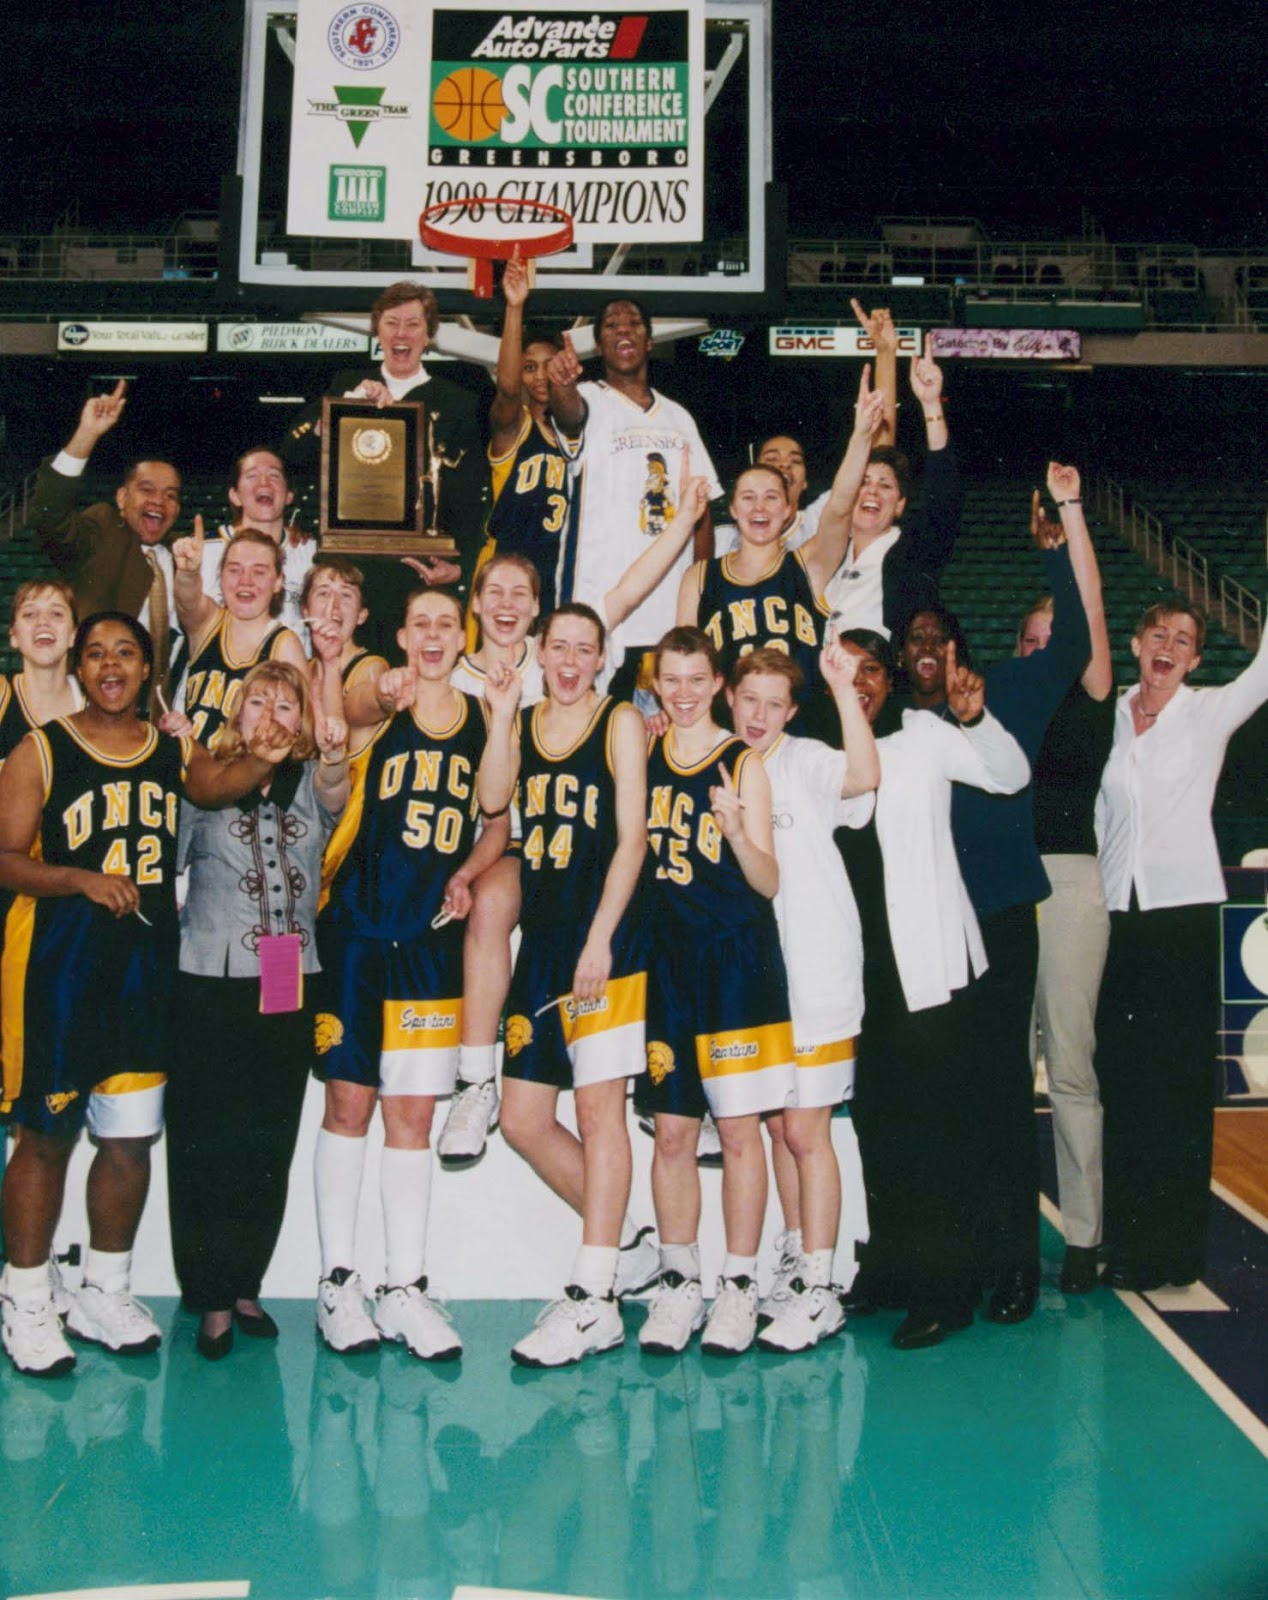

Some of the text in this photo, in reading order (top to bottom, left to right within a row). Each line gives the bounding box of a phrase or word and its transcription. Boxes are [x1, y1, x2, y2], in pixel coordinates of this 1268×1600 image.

[331, 6, 397, 59] SOUTHERN CONFERENCE
[487, 15, 616, 40] Advance
[471, 40, 610, 58] Auto Parts
[566, 67, 676, 91] SOUTHERN
[314, 102, 408, 118] THE GREEN TEAM
[501, 63, 565, 144] SC
[564, 92, 682, 117] CONFERENCE
[563, 118, 687, 143] TOURNAMENT
[431, 148, 687, 167] GREENSBORO
[424, 179, 689, 225] 1998 CHAMPIONS
[260, 338, 357, 349] BUICK DEALERS
[261, 325, 326, 337] PIEDMONT
[775, 337, 835, 350] GMC
[856, 337, 916, 350] GC
[379, 750, 478, 821] UNC
[402, 799, 463, 854] 50
[524, 824, 573, 870] 44
[102, 835, 163, 885] 42
[401, 1007, 455, 1031] Spatans
